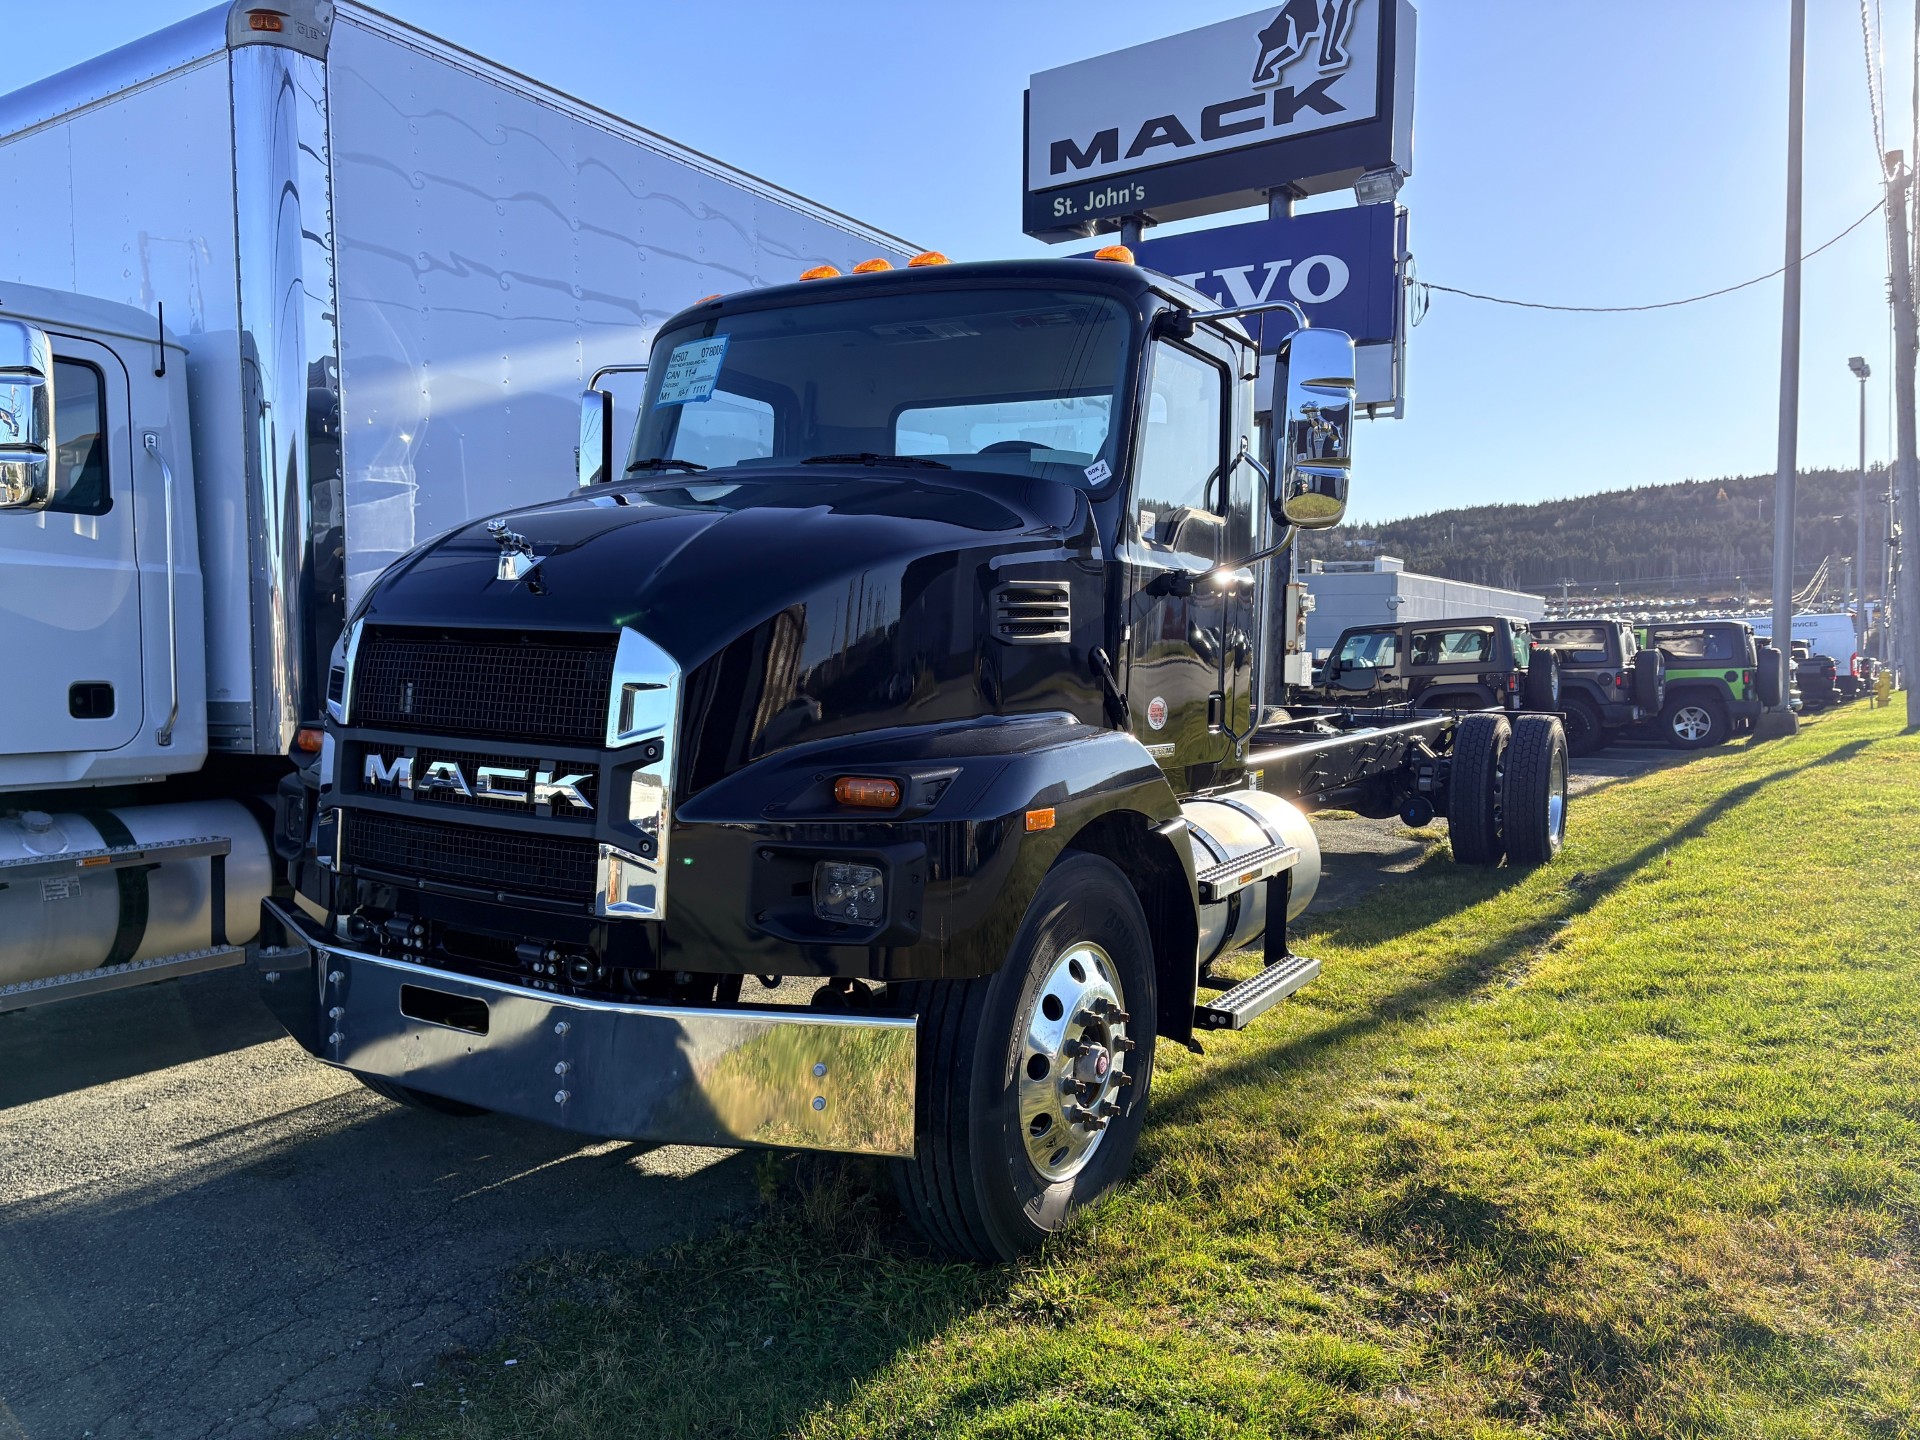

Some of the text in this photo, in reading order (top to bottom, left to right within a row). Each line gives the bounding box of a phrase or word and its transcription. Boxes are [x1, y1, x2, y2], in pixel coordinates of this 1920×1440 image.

[1050, 73, 1347, 175] MACK
[1053, 183, 1145, 217] St. John's
[1172, 254, 1350, 308] LVO
[364, 753, 594, 810] MACK
